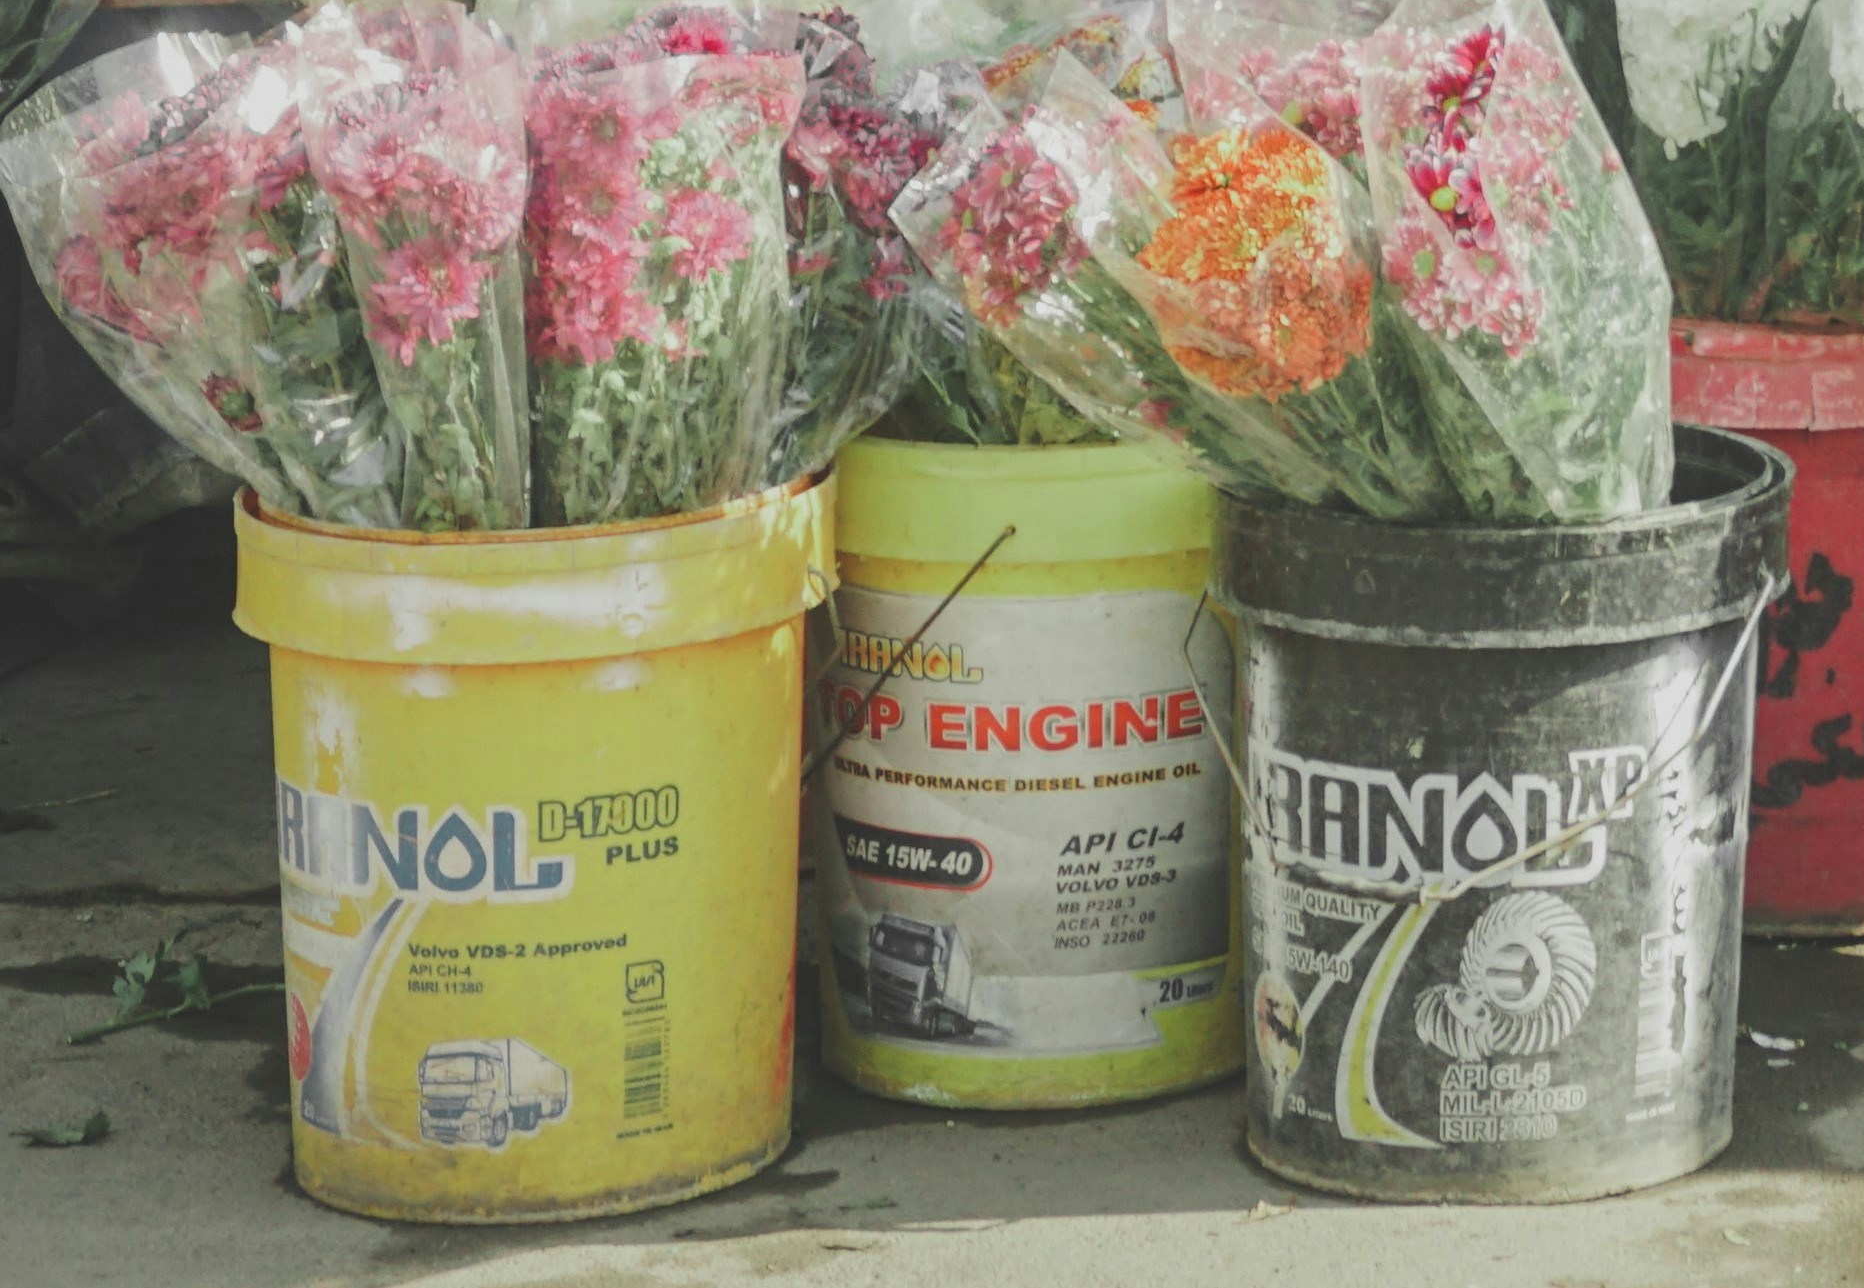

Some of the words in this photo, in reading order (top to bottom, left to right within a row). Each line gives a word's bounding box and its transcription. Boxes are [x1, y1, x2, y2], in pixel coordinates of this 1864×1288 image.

[818, 679, 904, 742] TOP
[928, 688, 1205, 753] ENGINE
[875, 767, 1007, 792] PERFORMANCE
[1014, 776, 1086, 793] DIESEL
[1093, 767, 1167, 789] ENGINE
[1173, 761, 1201, 779] OIL
[538, 784, 680, 843] D-17000
[606, 836, 680, 866] PLUS
[846, 833, 880, 863] SAE
[1060, 831, 1118, 857] API
[1126, 821, 1186, 851] CI-4
[1056, 863, 1101, 877] MAN
[1111, 855, 1156, 874] 3275
[1056, 877, 1120, 895] VOLVO
[1126, 869, 1178, 889] VDS-3
[1056, 901, 1081, 915] MB
[1304, 894, 1382, 922] QUALITY
[1056, 917, 1101, 933] ACEA
[408, 943, 460, 960] Volvo
[466, 943, 528, 960] VDS-2
[533, 933, 628, 959] Approved
[1054, 935, 1091, 951] INSO
[408, 964, 434, 978] API
[436, 964, 472, 978] CH-4
[1286, 946, 1352, 981] 5W-140
[444, 981, 485, 994] 11380
[1159, 977, 1184, 1003] 20
[1443, 1064, 1488, 1090] API
[1490, 1064, 1551, 1090] GL-5
[1440, 1116, 1499, 1142] ISIRI
